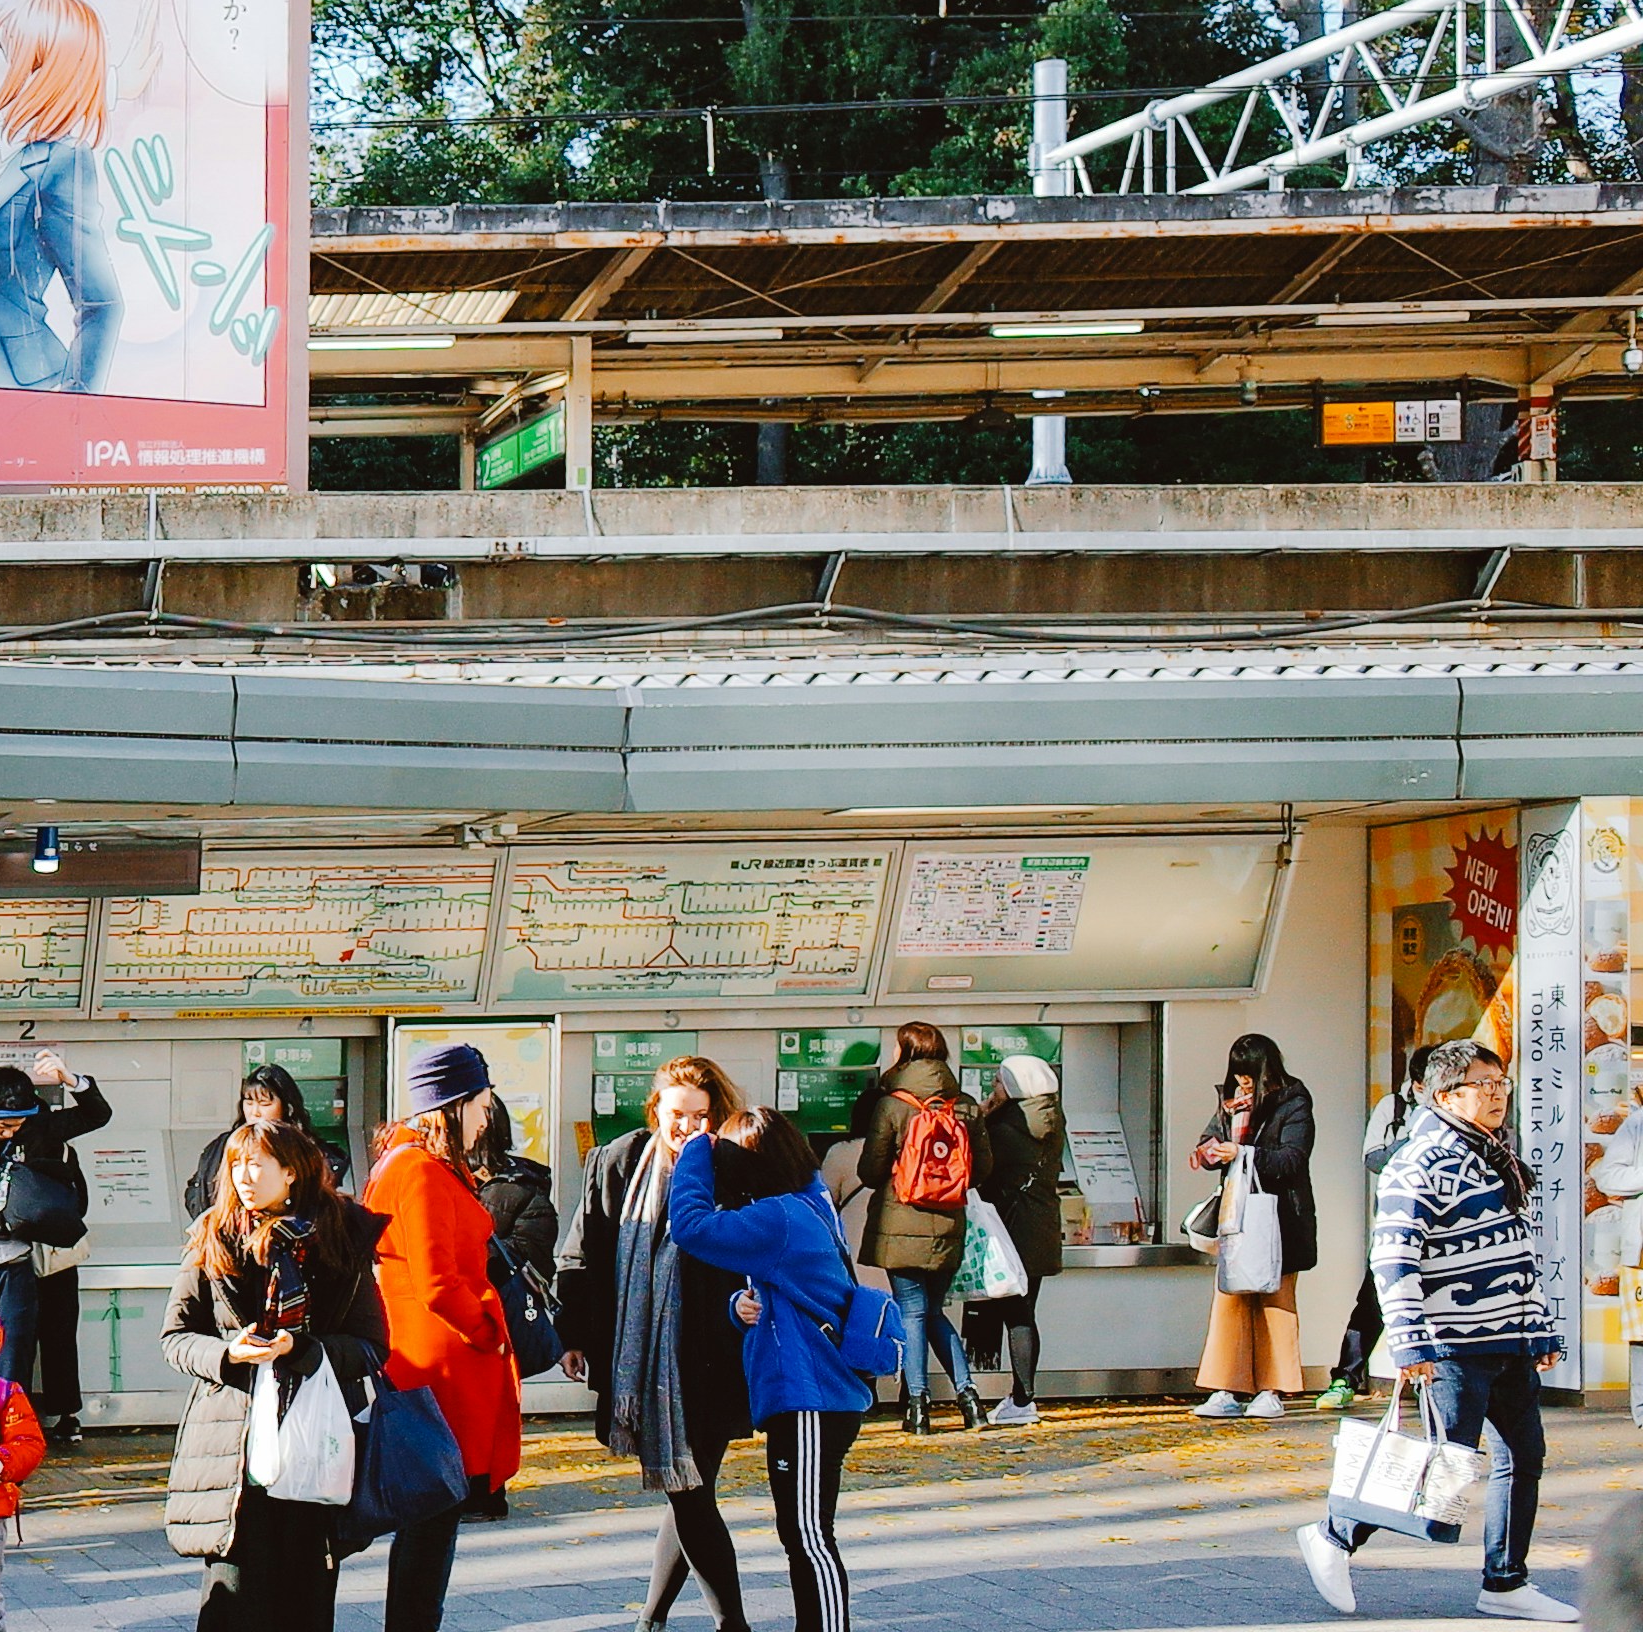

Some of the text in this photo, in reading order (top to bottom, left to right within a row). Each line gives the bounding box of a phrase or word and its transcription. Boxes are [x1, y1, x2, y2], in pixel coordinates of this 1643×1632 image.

[85, 439, 131, 468] IPA
[137, 449, 267, 467] 情報処理推進機構
[1464, 854, 1499, 893] NEW
[1466, 889, 1513, 934] OPEN!
[19, 1019, 36, 1041] 2
[623, 1058, 651, 1068] Ticket
[1531, 990, 1544, 1237] TOKYO MILK CHEESE
